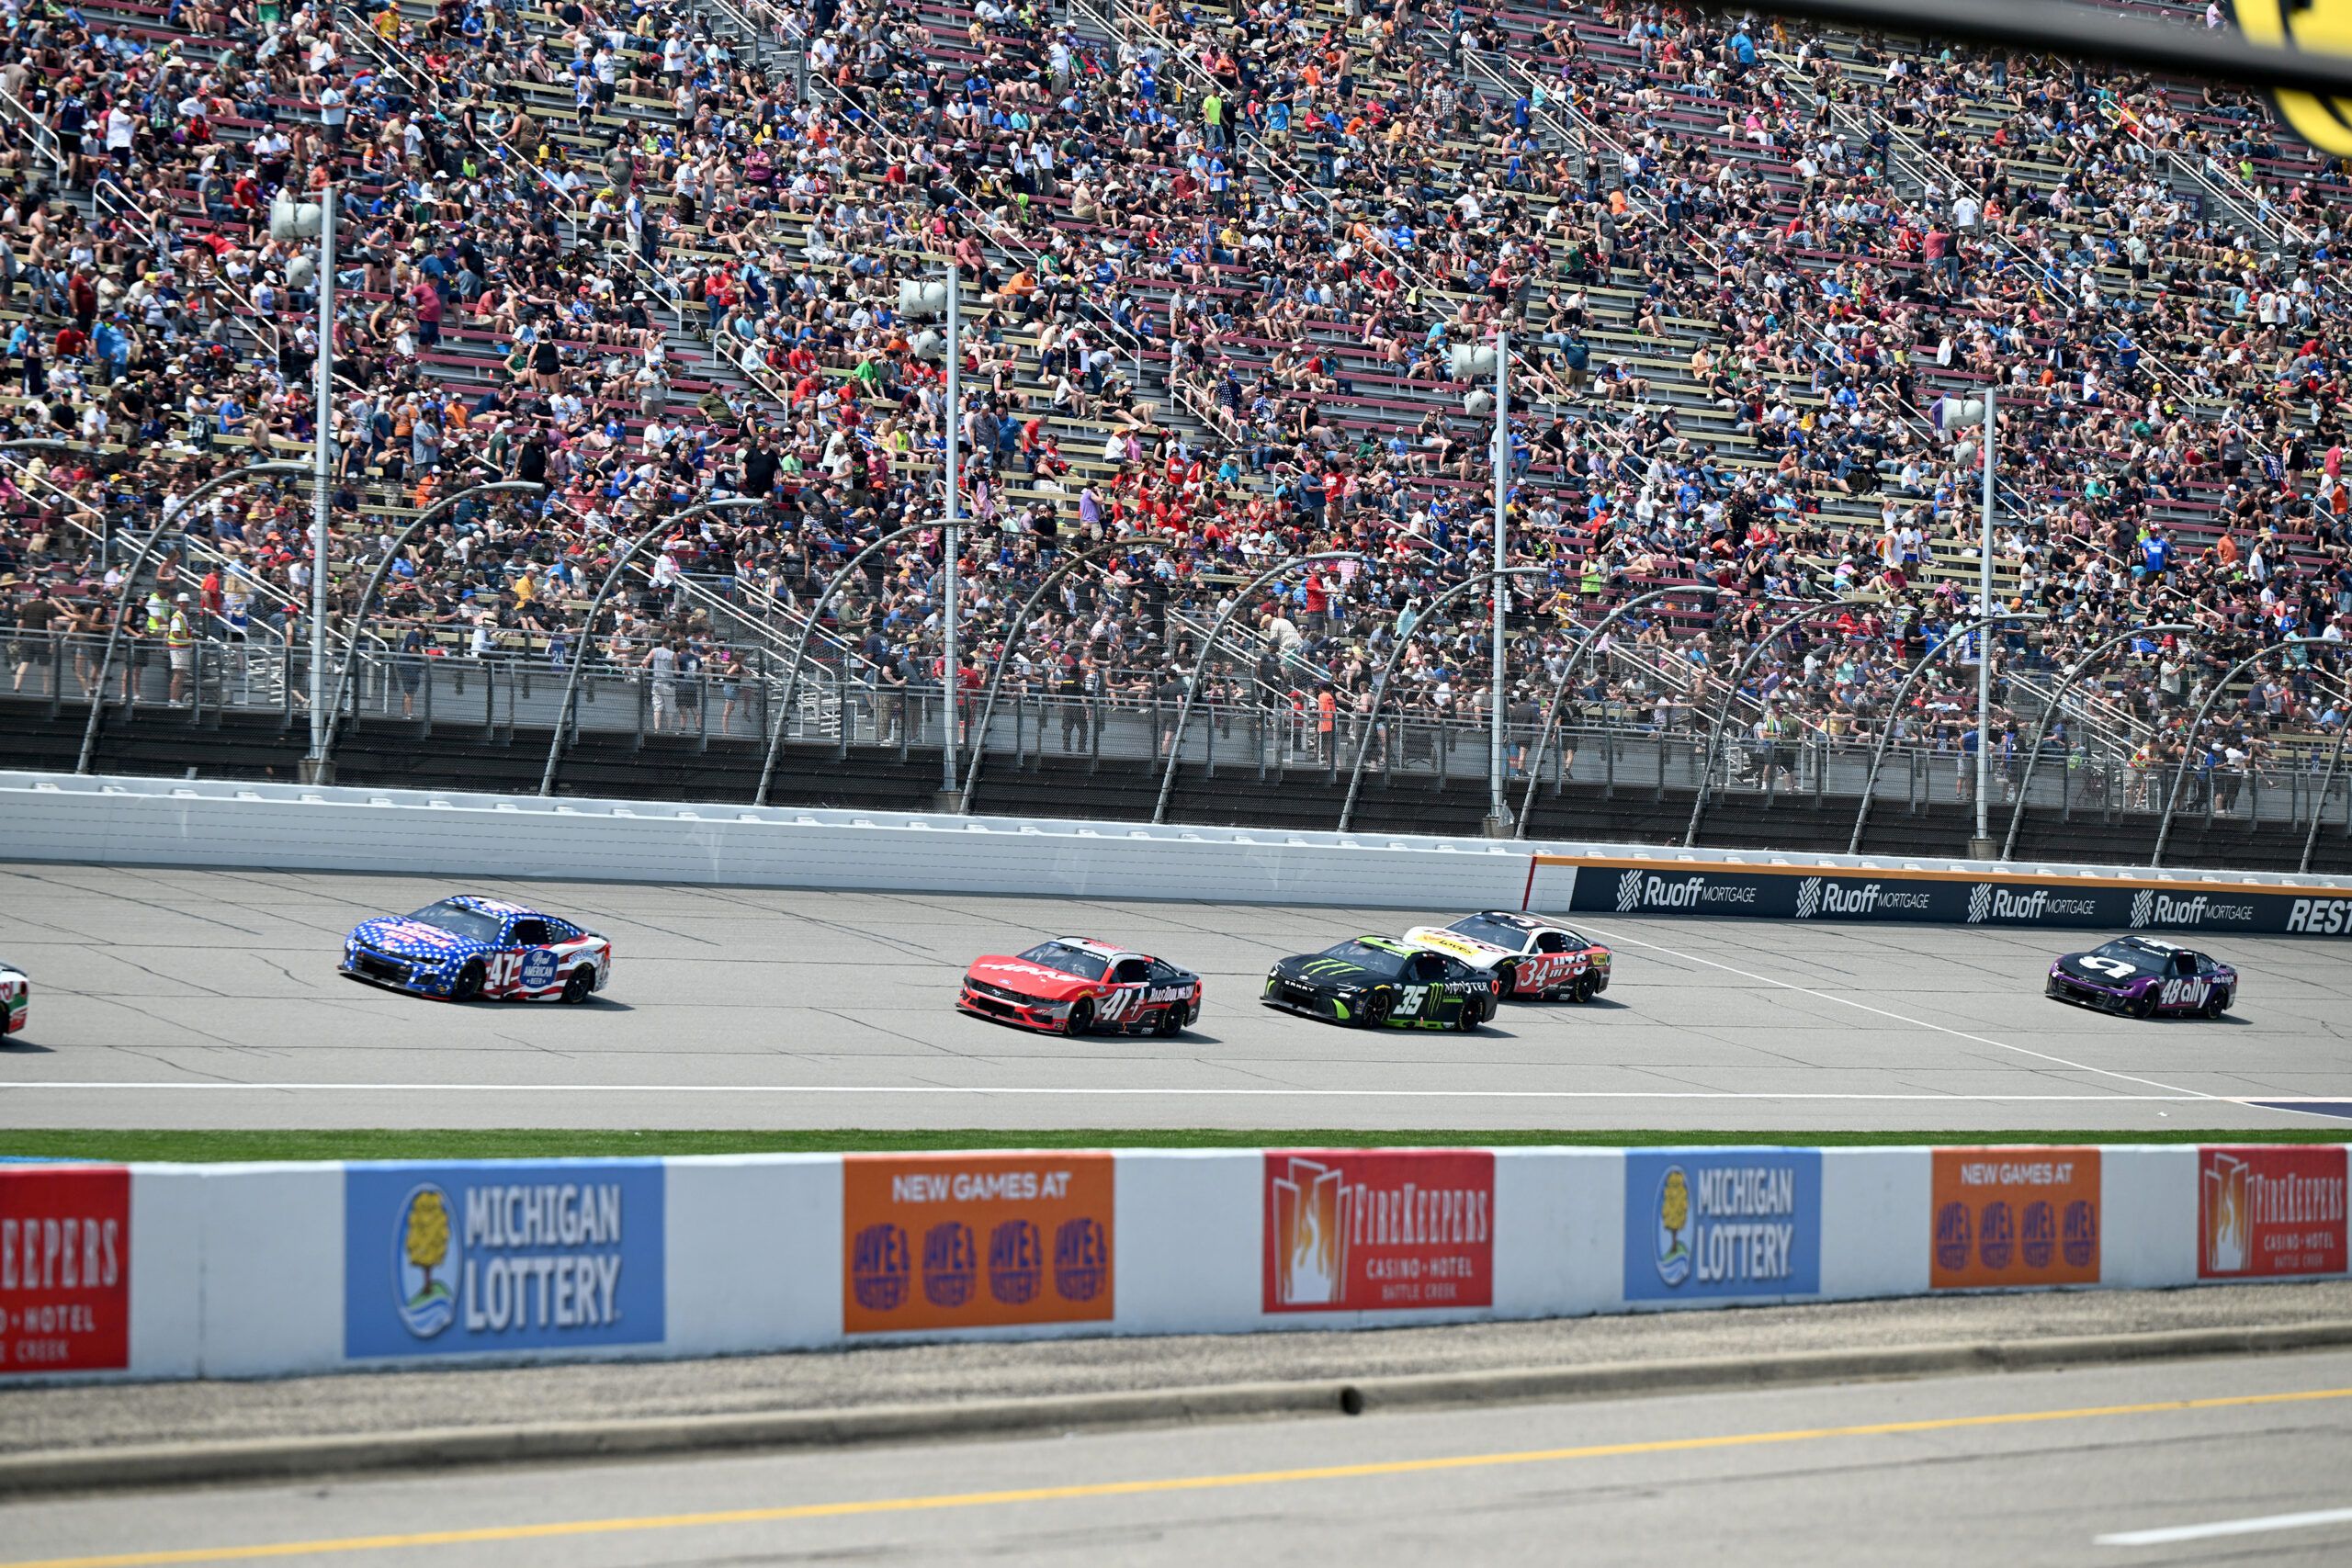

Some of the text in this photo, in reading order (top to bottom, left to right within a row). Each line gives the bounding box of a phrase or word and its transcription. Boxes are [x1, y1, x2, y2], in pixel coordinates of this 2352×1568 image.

[552, 650, 564, 665] 24
[1644, 876, 1758, 907] Ruoff MORTGAGE
[1821, 883, 1930, 913] Ruoff MORTGAGE
[1992, 889, 2096, 919] Ruoff MORTGAGE
[2153, 894, 2254, 924] Ruoff MORTGAGE
[490, 953, 516, 986] 47
[523, 965, 553, 976] AMERICAN
[1521, 960, 1550, 987] 34
[1549, 953, 1587, 977] MTS
[2212, 976, 2221, 984] do
[2221, 976, 2226, 984] it
[1393, 986, 1429, 1015] 35
[1444, 981, 1490, 995] MONSTER
[2161, 976, 2211, 1009] 48 ally
[1101, 988, 1132, 1021] 41
[892, 1170, 1072, 1202] NEW GAMES AT
[1961, 1162, 2075, 1185] NEW GAMES AT
[1698, 1168, 1793, 1215] MICHIGAN
[2256, 1172, 2343, 1224] FIREKEEPERS
[466, 1184, 621, 1247] MICHIGAN
[1354, 1182, 1487, 1246] FIREKEEPERS
[1697, 1224, 1793, 1280] LOTTERY
[2264, 1232, 2335, 1251] CASINO HOTEL
[1366, 1256, 1474, 1279] CASINO HOTEL
[466, 1255, 621, 1330] LOTTERY
[24, 1304, 95, 1332] HOTEL
